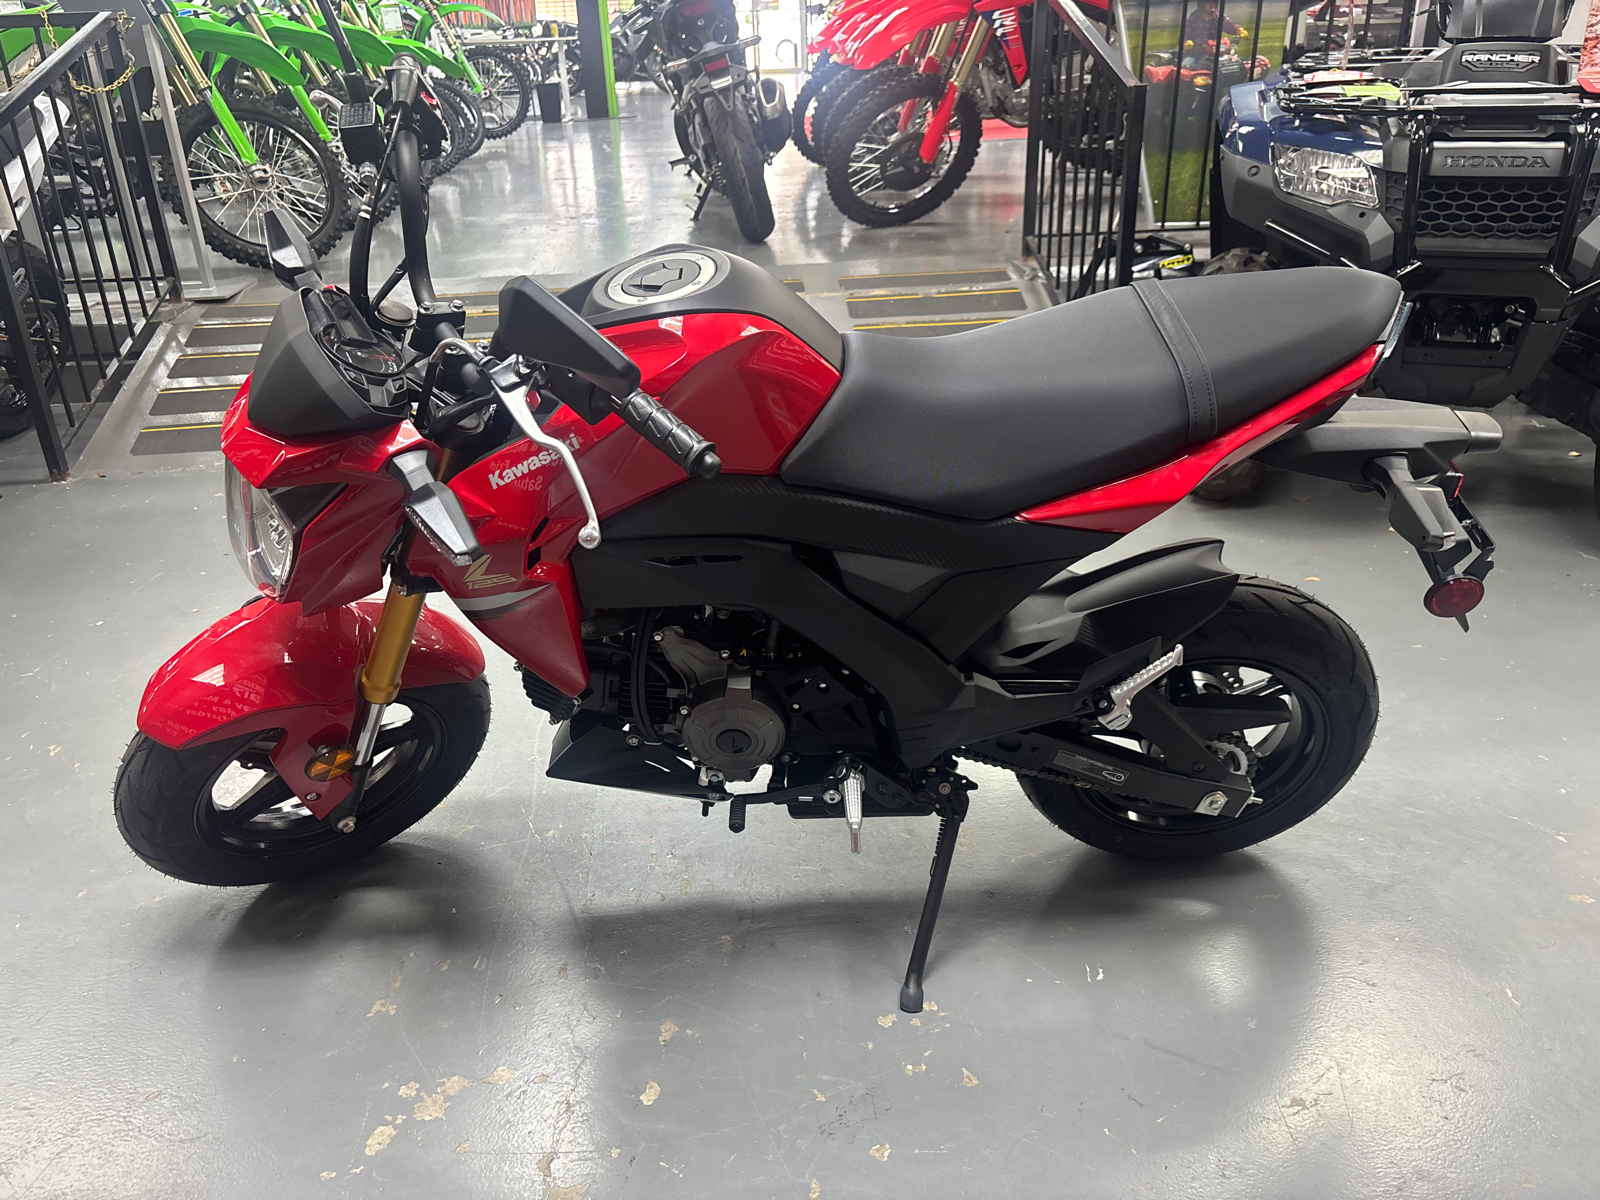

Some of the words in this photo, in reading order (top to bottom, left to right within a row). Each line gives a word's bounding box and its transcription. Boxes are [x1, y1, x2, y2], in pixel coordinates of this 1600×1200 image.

[1461, 54, 1541, 63] RANCHER
[1443, 155, 1550, 168] HONDA
[466, 574, 518, 590] 125
